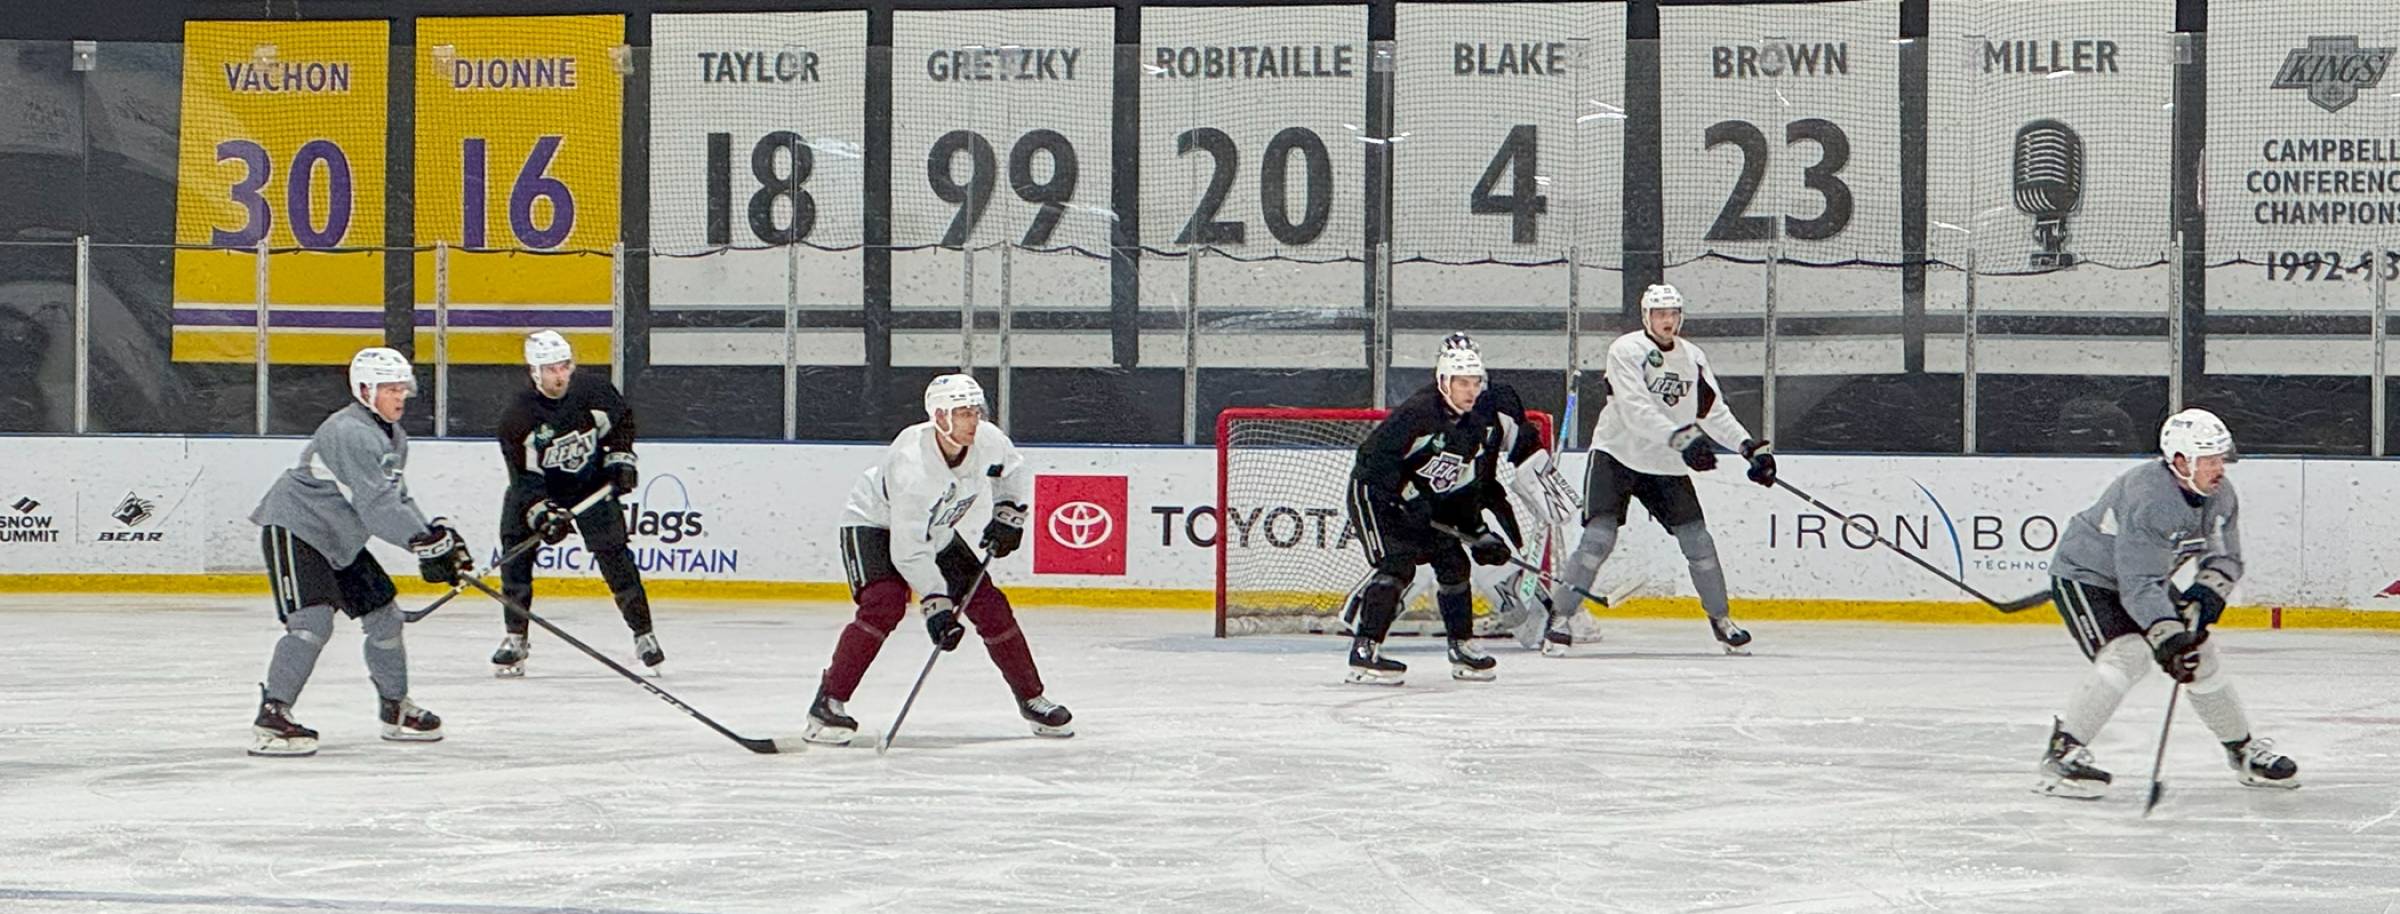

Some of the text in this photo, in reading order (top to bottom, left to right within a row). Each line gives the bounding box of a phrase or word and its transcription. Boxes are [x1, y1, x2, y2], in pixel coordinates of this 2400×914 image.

[453, 58, 577, 89] DIONNE
[699, 50, 820, 83] TAYLOR
[927, 46, 1081, 82] GRETZKY
[1156, 45, 1354, 79] ROBITAILLE
[1453, 42, 1567, 76] BLAKE
[1712, 42, 1848, 79] BROWN
[1982, 40, 2120, 74] MILLER
[2281, 54, 2385, 82] KINGS
[224, 62, 350, 92] VACHON
[2263, 138, 2400, 162] CAMPBELL
[211, 138, 354, 250] 30
[462, 135, 577, 250] 16
[706, 130, 818, 246] 18
[927, 129, 1079, 247] 99
[1174, 126, 1333, 246] 20
[1470, 124, 1548, 244] 4
[1703, 118, 1855, 243] 23
[2254, 200, 2400, 225] CHAMPION
[0, 515, 52, 528] SNOW
[98, 532, 164, 542] BEAR
[620, 502, 703, 544] lags
[1769, 513, 1929, 550] IRON
[491, 546, 738, 573] GIC UNTAIN
